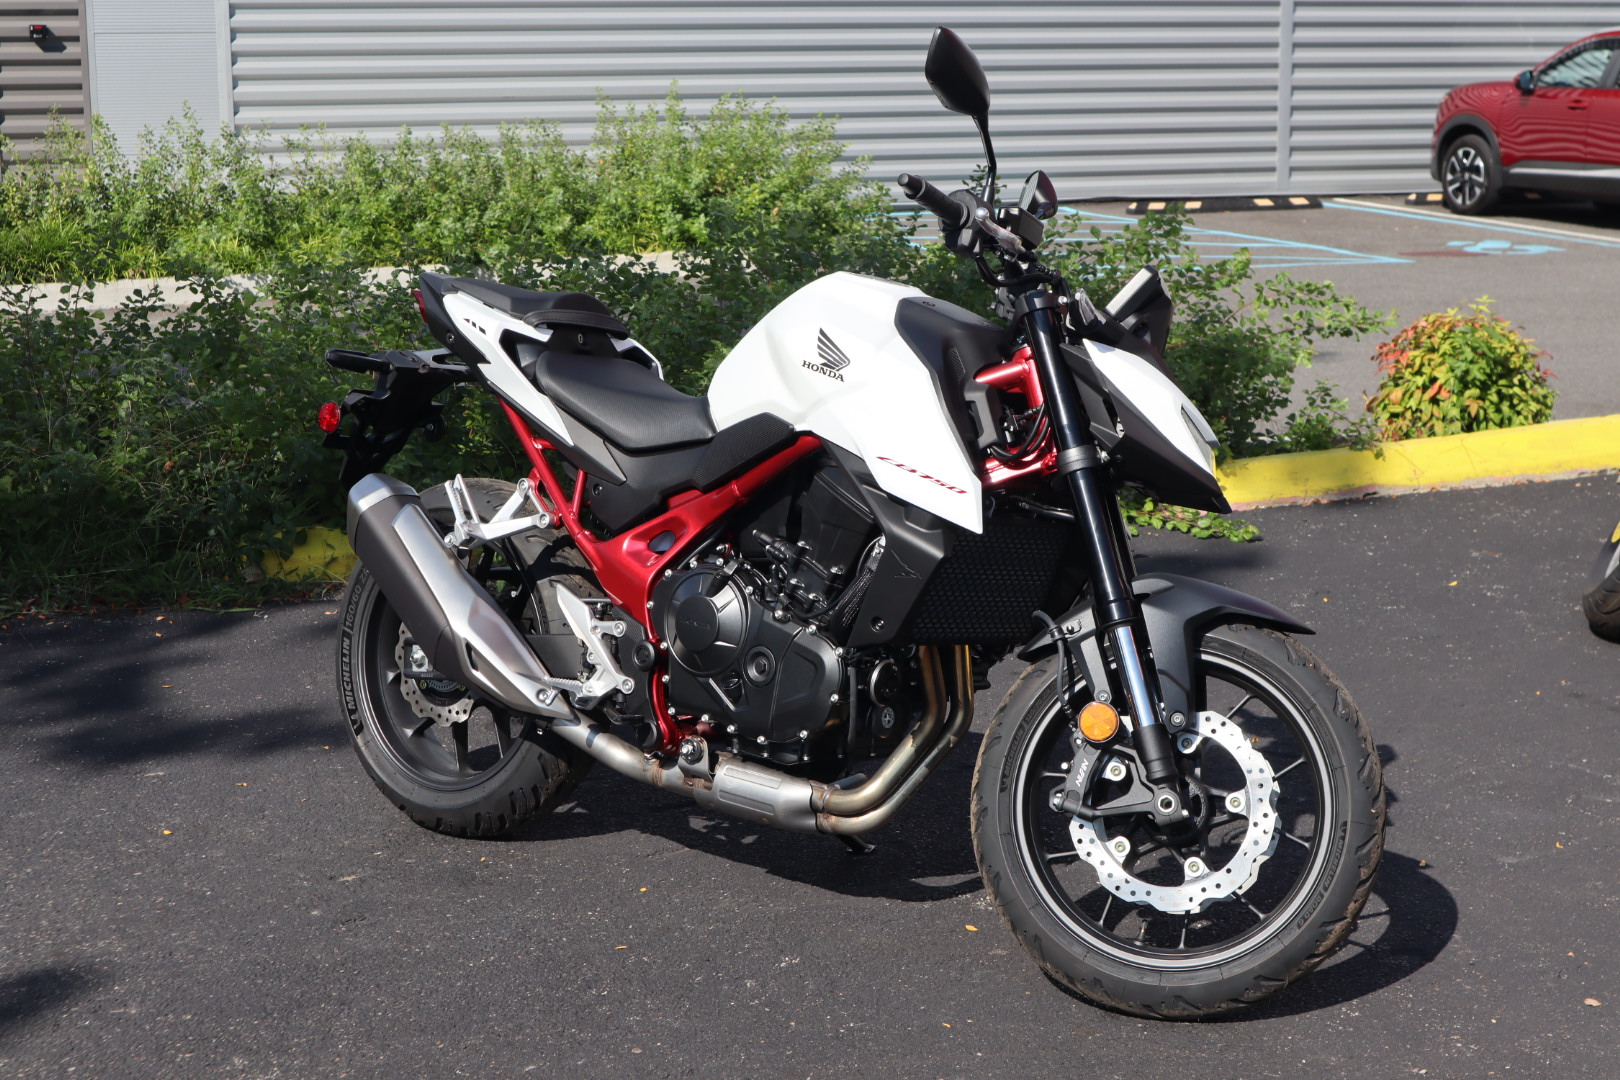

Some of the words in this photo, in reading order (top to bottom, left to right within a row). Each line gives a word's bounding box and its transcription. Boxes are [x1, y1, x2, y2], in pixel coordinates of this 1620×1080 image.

[801, 359, 845, 383] HONDA
[345, 584, 362, 627] 160/60
[342, 637, 356, 710] MICHELIN
[1003, 727, 1024, 776] MICHELIN
[1323, 839, 1344, 888] MICHELIN
